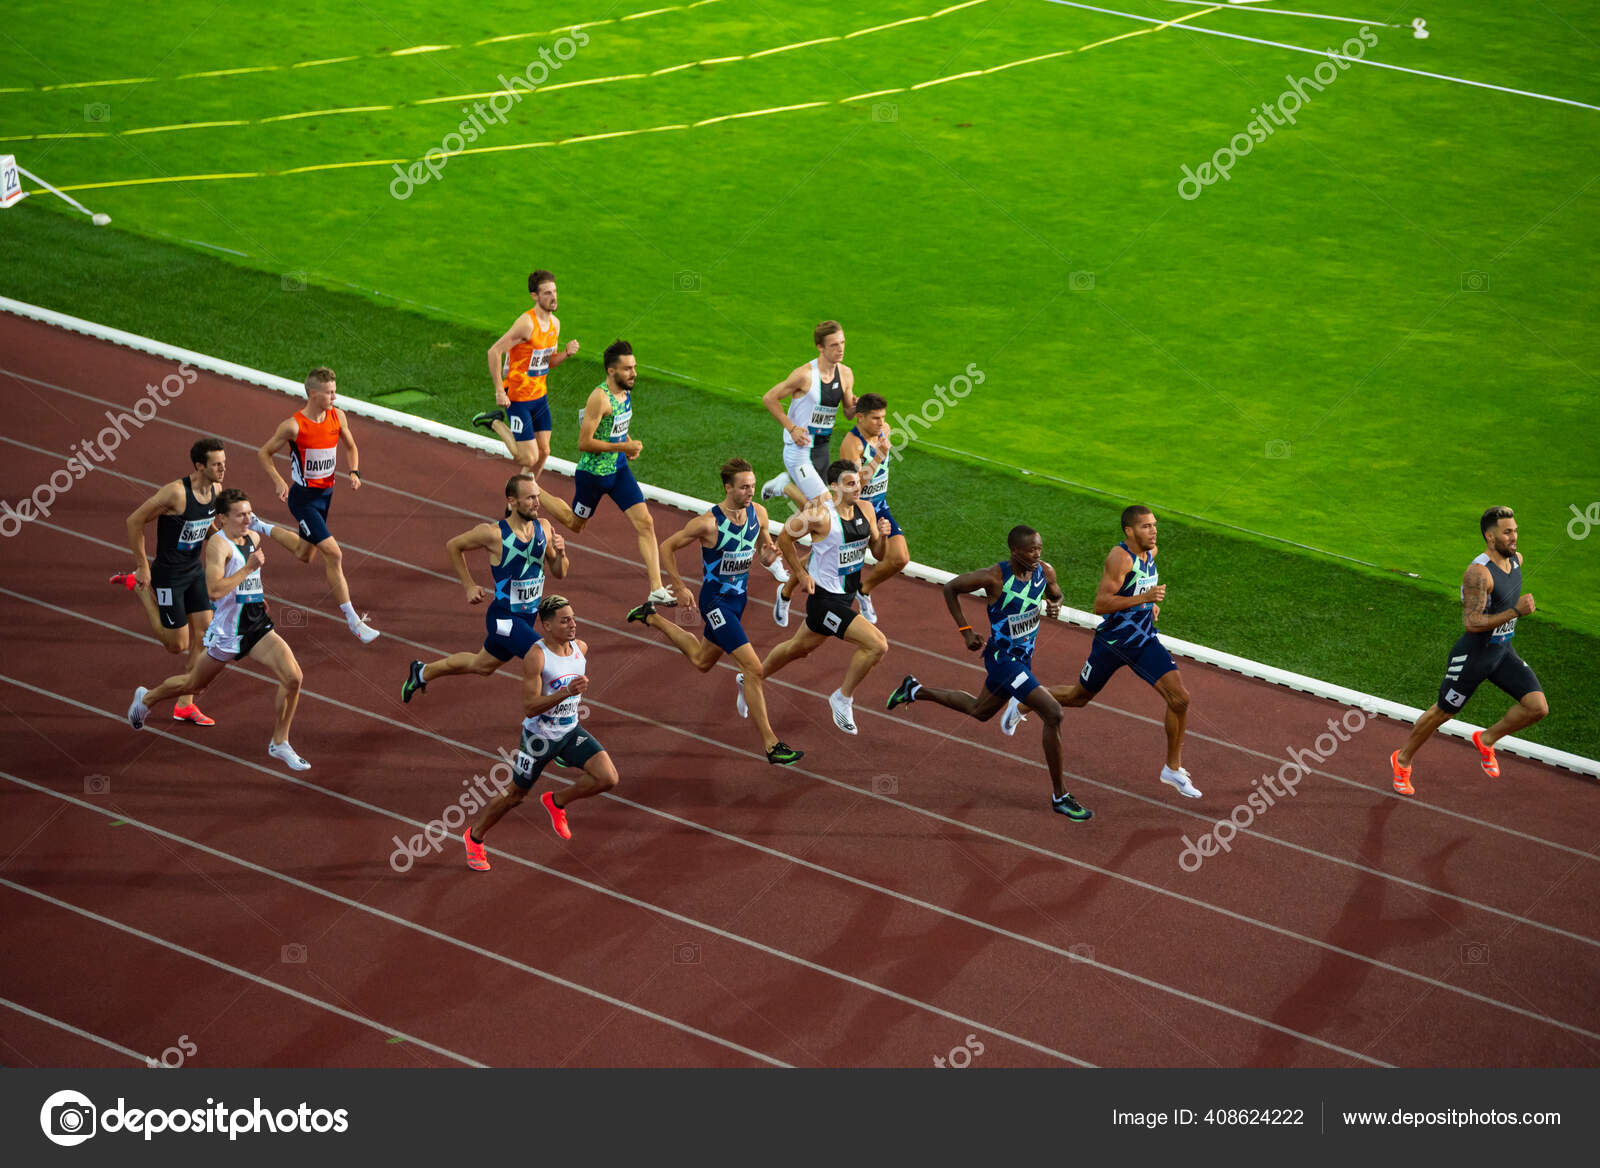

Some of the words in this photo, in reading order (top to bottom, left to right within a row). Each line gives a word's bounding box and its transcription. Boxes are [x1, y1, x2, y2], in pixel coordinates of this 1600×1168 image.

[4, 168, 17, 191] 22
[517, 585, 540, 601] TUKA
[710, 611, 722, 626] 15
[520, 756, 530, 771] 18
